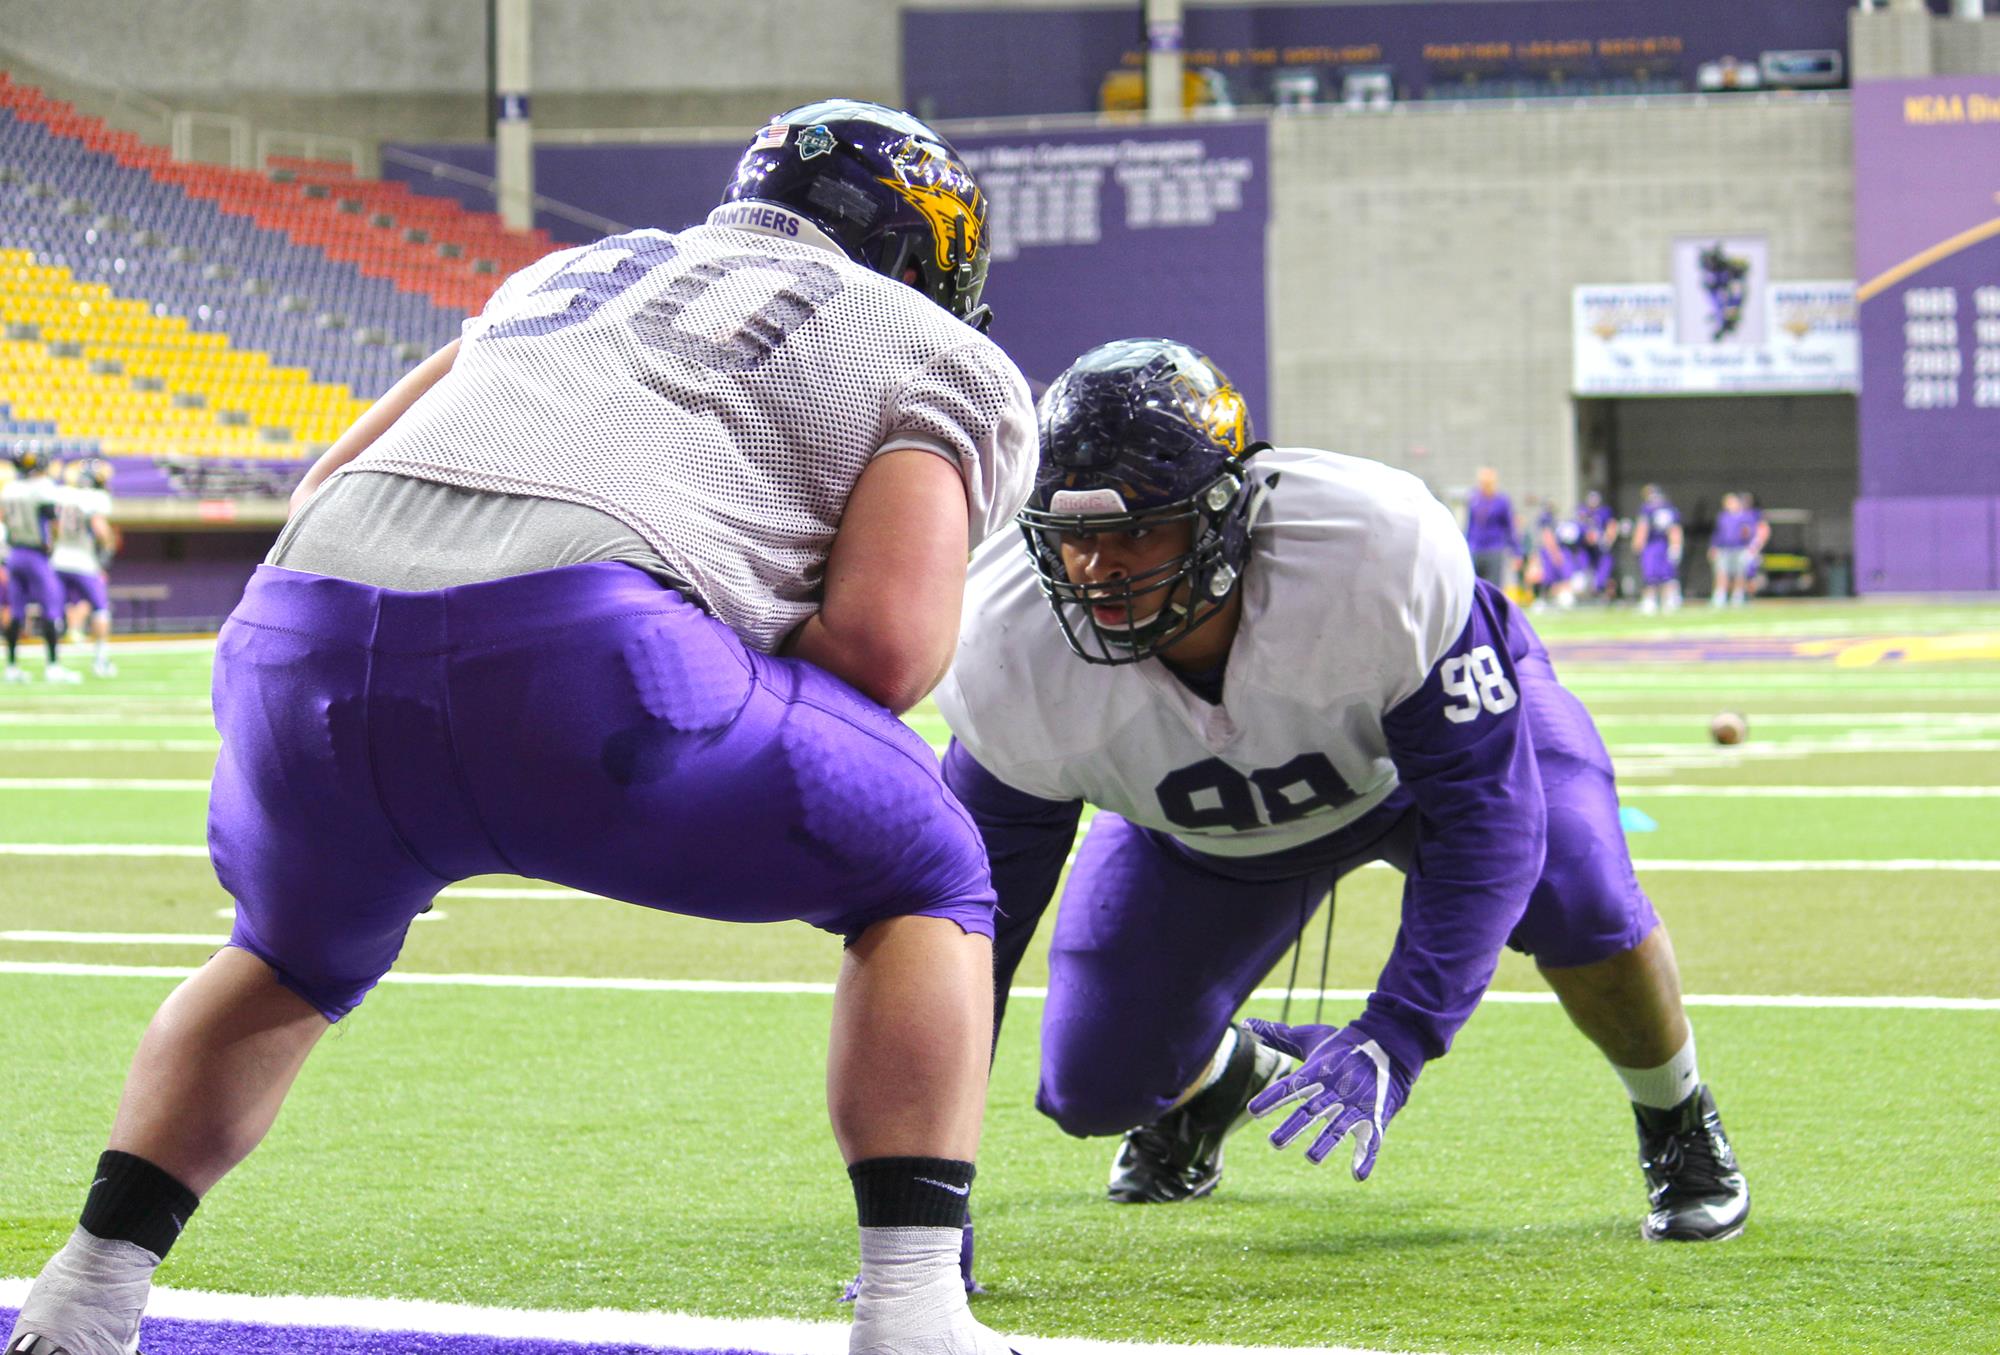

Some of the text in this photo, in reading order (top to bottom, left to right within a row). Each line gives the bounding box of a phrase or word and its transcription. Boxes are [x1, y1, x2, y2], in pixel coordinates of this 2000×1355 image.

[1904, 94, 1965, 124] NCAA
[712, 206, 800, 237] PANTHERS
[1439, 645, 1518, 724] 98
